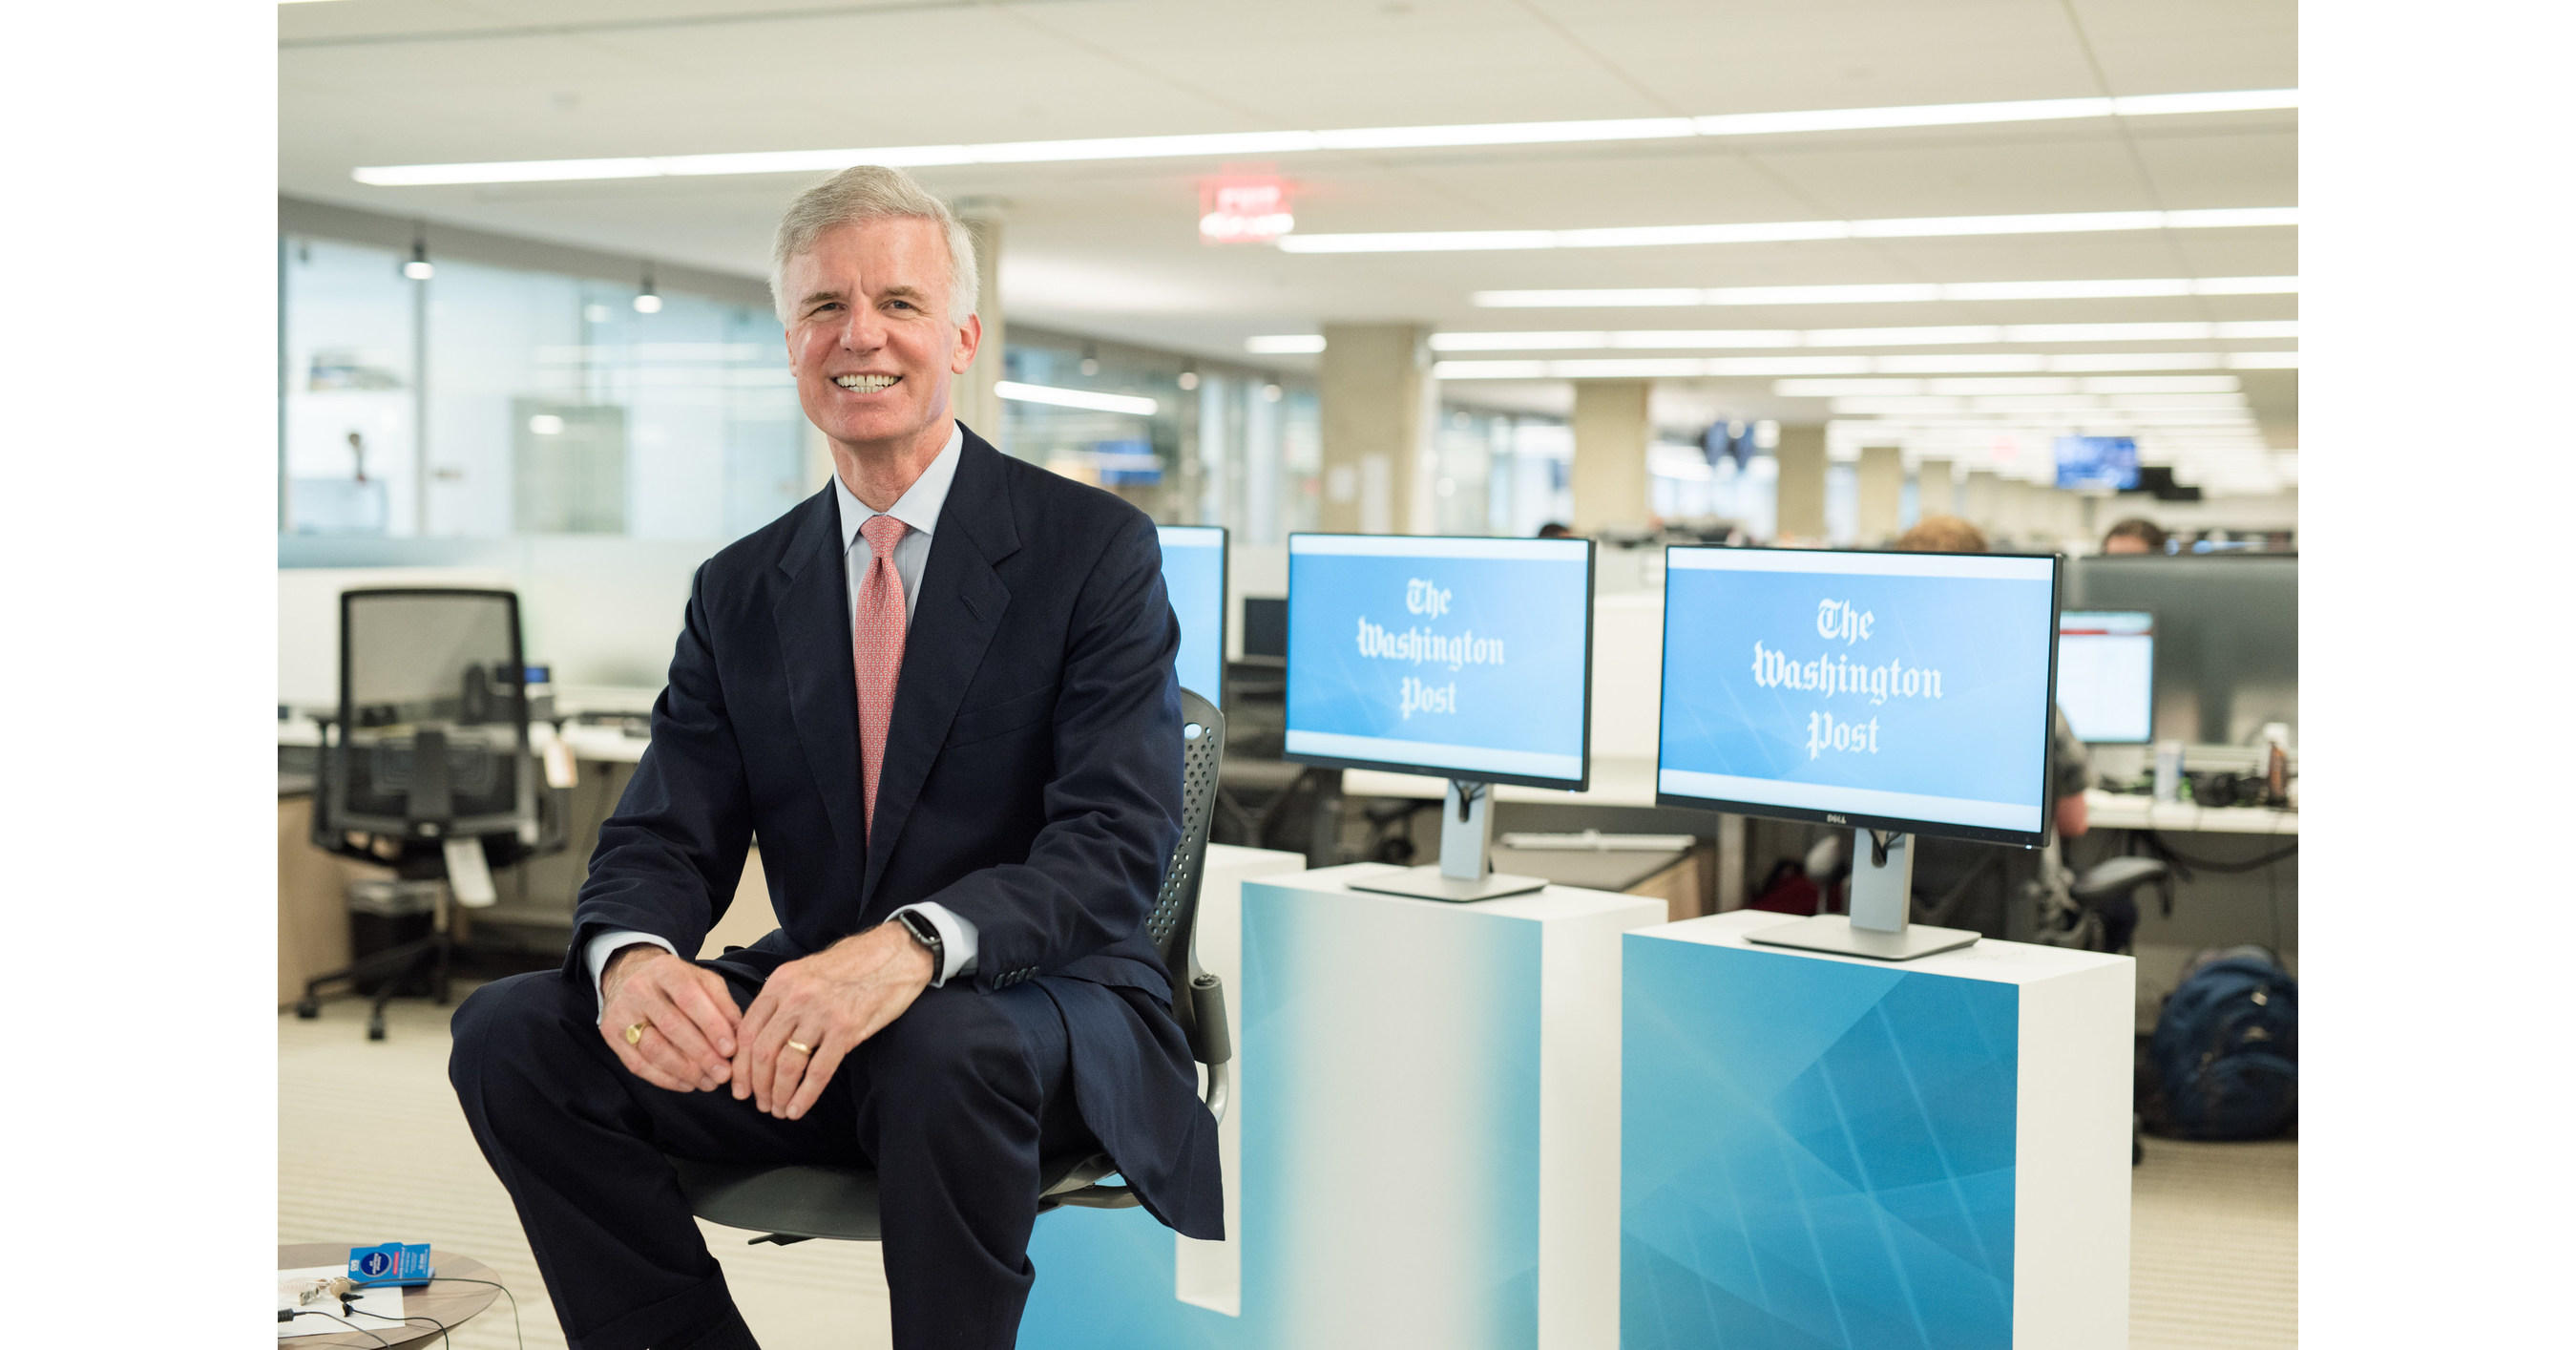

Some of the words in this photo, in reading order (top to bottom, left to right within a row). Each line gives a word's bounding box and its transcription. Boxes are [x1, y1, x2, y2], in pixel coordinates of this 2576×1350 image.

[1406, 578, 1453, 619] The
[1817, 599, 1875, 646] The
[1356, 616, 1505, 671] Washington
[1751, 640, 1943, 706] Washington
[1399, 677, 1456, 721] Post
[1805, 710, 1880, 760] Post
